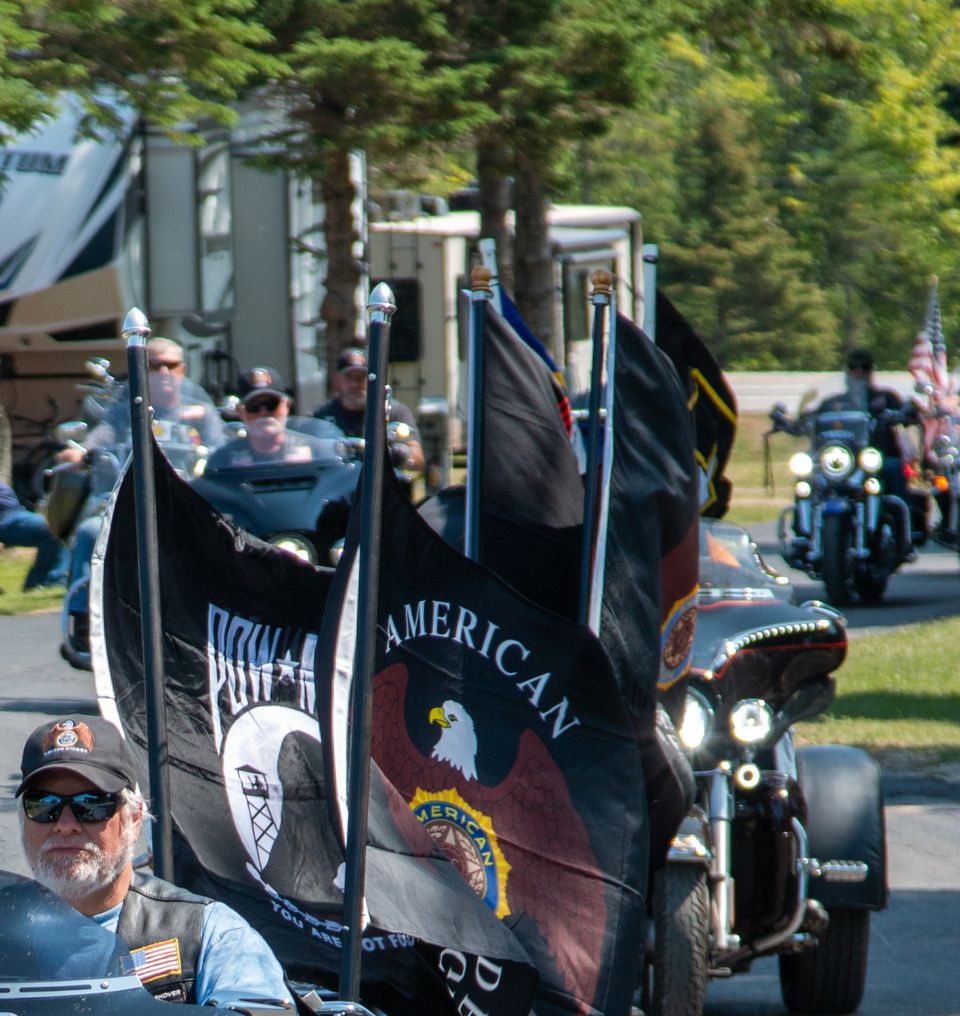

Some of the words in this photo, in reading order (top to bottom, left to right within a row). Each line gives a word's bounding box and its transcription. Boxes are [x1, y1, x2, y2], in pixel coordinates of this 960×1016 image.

[384, 599, 581, 740] AMERICAN
[415, 804, 494, 867] MERICAN
[271, 900, 304, 929] YOU
[310, 927, 343, 948] ARE
[360, 935, 387, 952] OT
